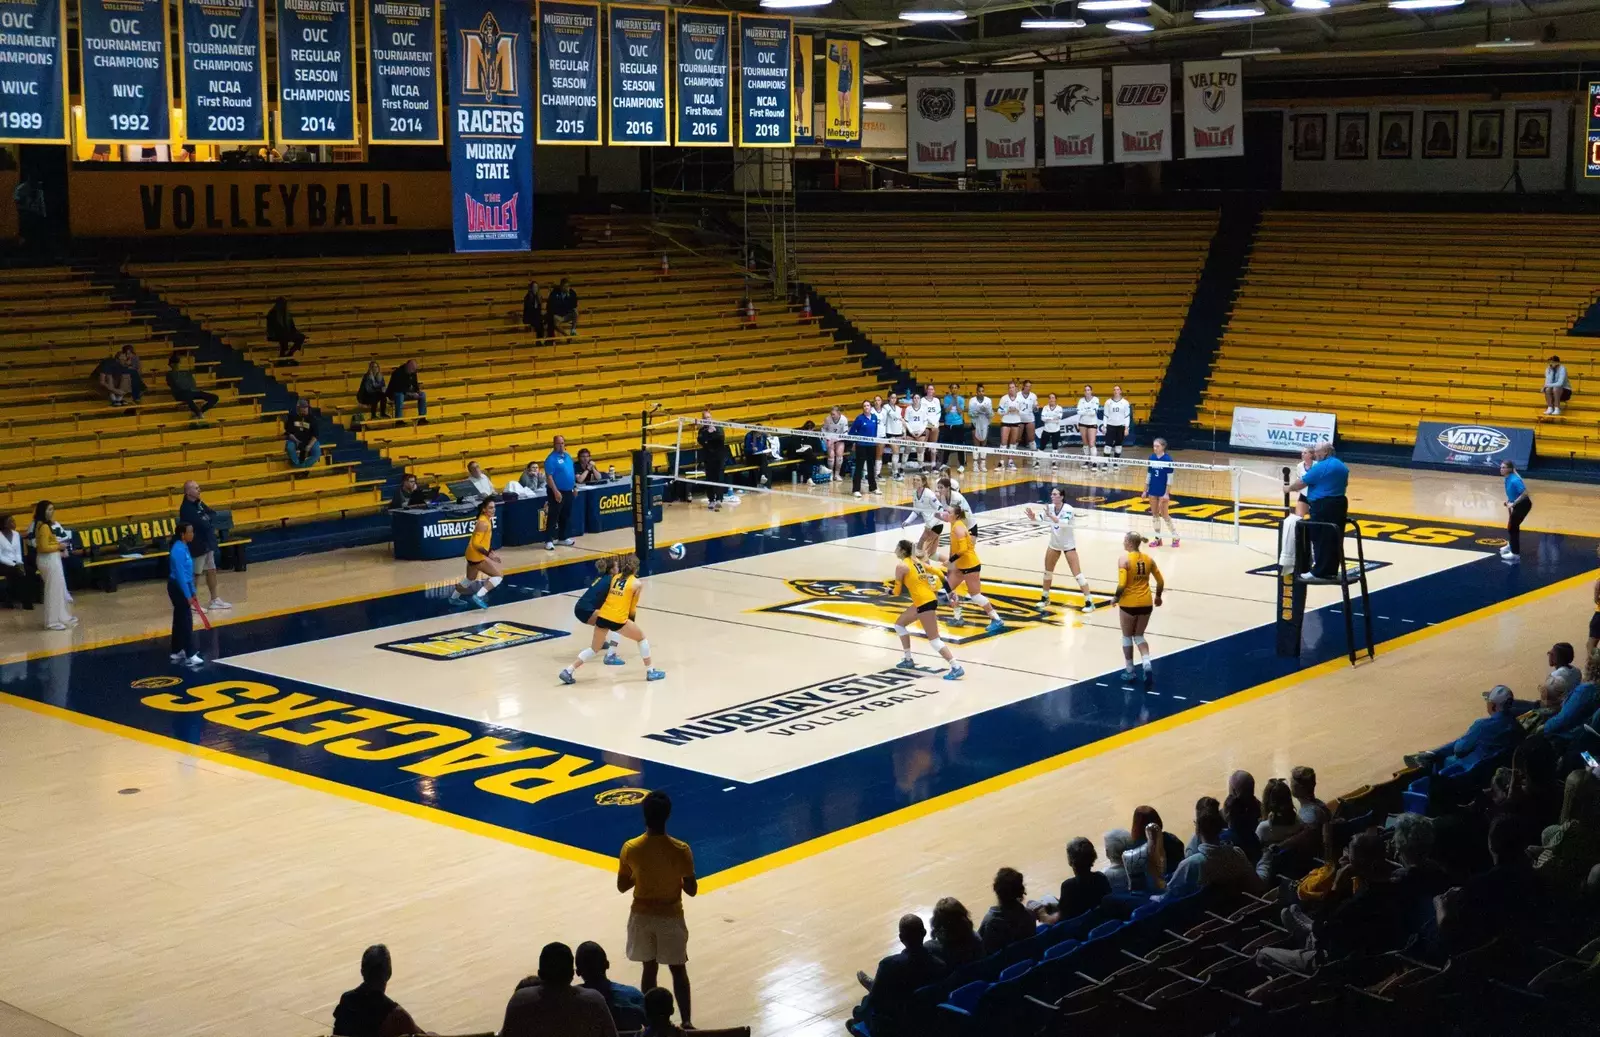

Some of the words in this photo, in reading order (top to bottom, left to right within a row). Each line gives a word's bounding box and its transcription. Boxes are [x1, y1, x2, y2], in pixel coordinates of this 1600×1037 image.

[284, 0, 320, 12] MURRAY
[320, 2, 345, 13] STATE
[374, 4, 408, 16] MURRAY
[408, 7, 431, 18] STATE
[2, 12, 33, 29] OVC
[110, 18, 140, 35] OVC
[544, 14, 573, 26] MURRAY
[574, 16, 593, 27] STATE
[615, 19, 641, 30] MURRAY
[642, 21, 661, 31] STATE
[209, 23, 237, 39] OVC
[303, 28, 329, 43] OVC
[682, 24, 708, 34] MURRAY
[708, 25, 725, 35] STATE
[745, 29, 770, 39] MURRAY
[770, 30, 787, 39] STATE
[86, 37, 162, 52] TOURNAMENT
[392, 32, 416, 46] OVC
[187, 42, 256, 56] TOURNAMENT
[559, 40, 580, 54] OVC
[629, 44, 648, 57] OVC
[291, 49, 341, 63] REGULAR
[373, 49, 433, 62] TOURNAMENT
[695, 48, 714, 60] OVC
[757, 52, 776, 64] OVC
[94, 54, 159, 69] CHAMPIONS
[193, 59, 253, 72] CHAMPIONS
[549, 59, 589, 72] REGULAR
[295, 69, 338, 82] SEASON
[378, 65, 431, 77] CHAMPIONS
[620, 63, 658, 75] REGULAR
[679, 63, 727, 75] TOURNAMENT
[743, 66, 788, 77] TOURNAMENT
[552, 77, 587, 89] SEASON
[622, 80, 655, 92] SEASON
[684, 77, 724, 87] CHAMPIONS
[747, 79, 786, 90] CHAMPIONS
[1188, 71, 1238, 88] VALPO
[1, 80, 38, 95] WIVC
[113, 84, 144, 98] NIVC
[209, 80, 242, 93] NCAA
[391, 84, 420, 97] NCAA
[283, 88, 350, 102] CHAMPIONS
[542, 94, 597, 107] CHAMPIONS
[693, 94, 715, 105] NCAA
[984, 87, 1029, 107] UNI
[1116, 83, 1168, 106] UIC
[197, 96, 220, 107] First
[222, 96, 252, 108] Round
[382, 99, 400, 109] First
[402, 99, 429, 110] Round
[613, 97, 664, 109] CHAMPIONS
[757, 96, 777, 107] NCAA
[685, 107, 701, 116] First
[702, 107, 723, 116] Round
[749, 109, 764, 118] First
[765, 109, 785, 118] Round
[0, 112, 42, 129] 1989
[109, 114, 150, 131] 1992
[207, 116, 245, 132] 2003
[301, 116, 336, 132] 2014
[389, 117, 422, 132] 2014
[457, 109, 524, 134] RACERS
[556, 120, 584, 133] 2015
[626, 121, 653, 135] 2016
[692, 123, 717, 136] 2016
[755, 124, 780, 137] 2018
[827, 128, 858, 138] Metzger
[1121, 129, 1164, 152] VALLEY
[1193, 124, 1237, 147] VALLEY
[916, 140, 957, 162] VALLEY
[985, 136, 1026, 159] VALLEY
[1053, 133, 1095, 156] VALLEY
[466, 143, 516, 160] MURRAY
[476, 163, 510, 179] STATE
[483, 193, 501, 202] THE
[140, 183, 398, 230] VOLLEYBALL
[465, 192, 519, 232] VALLEY
[1267, 429, 1329, 442] WALTER'S
[1447, 429, 1501, 446] VANCE
[1154, 469, 1159, 477] 3
[1103, 497, 1475, 544] RACRS
[423, 521, 469, 538] MURRAY
[1137, 562, 1145, 575] 11
[613, 578, 627, 590] 14
[642, 691, 830, 746] MURRAY
[767, 688, 940, 737] VOLLEYBALL
[140, 680, 640, 804] RACERS
